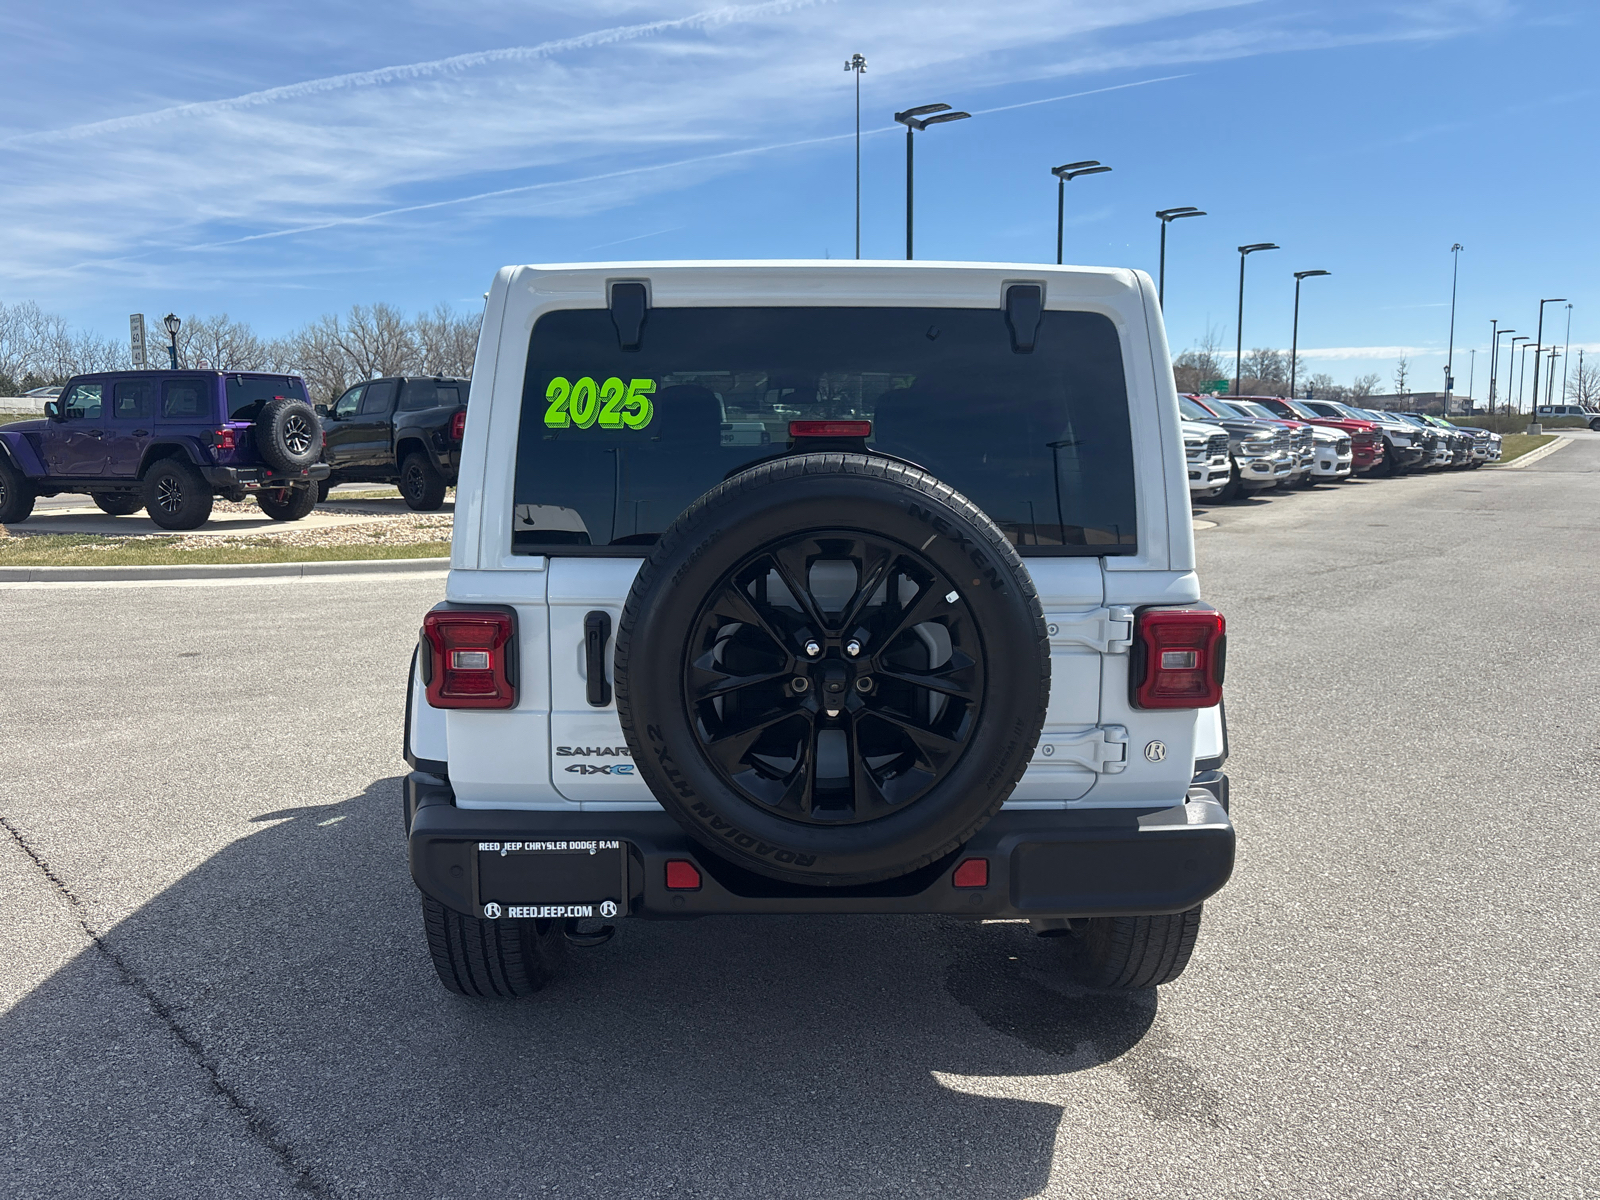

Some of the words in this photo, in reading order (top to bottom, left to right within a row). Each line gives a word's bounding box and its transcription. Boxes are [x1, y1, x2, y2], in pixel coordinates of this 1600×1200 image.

[132, 333, 140, 343] 60
[544, 376, 657, 430] 2025
[907, 502, 1005, 591] NEXEN
[646, 723, 664, 742] 2
[555, 746, 632, 757] SAHAR
[653, 745, 696, 799] HTX
[692, 801, 818, 867] ROADIAN
[478, 842, 500, 851] REED
[502, 842, 523, 851] JEEP
[524, 841, 568, 851] CHRYSLER
[569, 841, 598, 850] DODGE
[599, 840, 620, 849] RAM
[508, 905, 593, 918] REEDJEEP.COM
